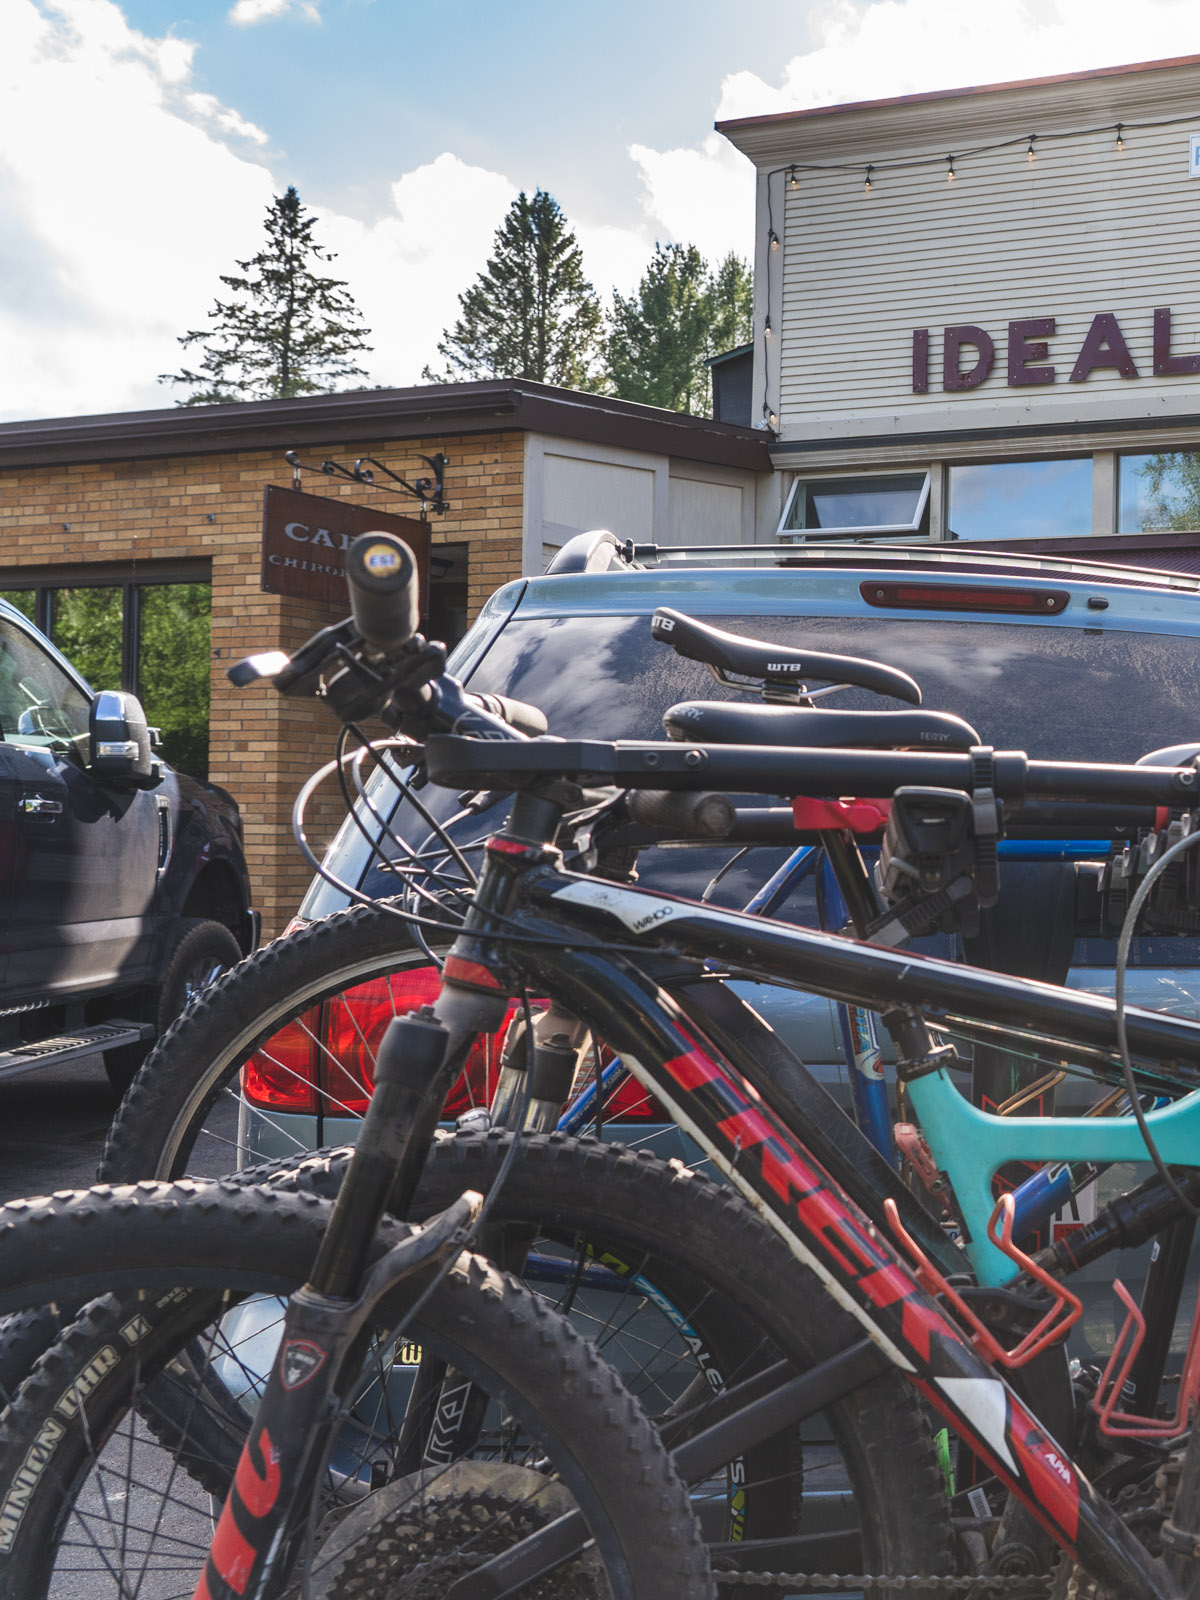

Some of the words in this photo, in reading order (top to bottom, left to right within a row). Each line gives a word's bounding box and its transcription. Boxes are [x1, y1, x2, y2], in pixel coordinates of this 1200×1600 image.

[767, 662, 801, 672] WTB
[662, 1018, 975, 1365] TREK
[0, 1417, 66, 1553] MINION
[56, 1345, 120, 1419] DHR
